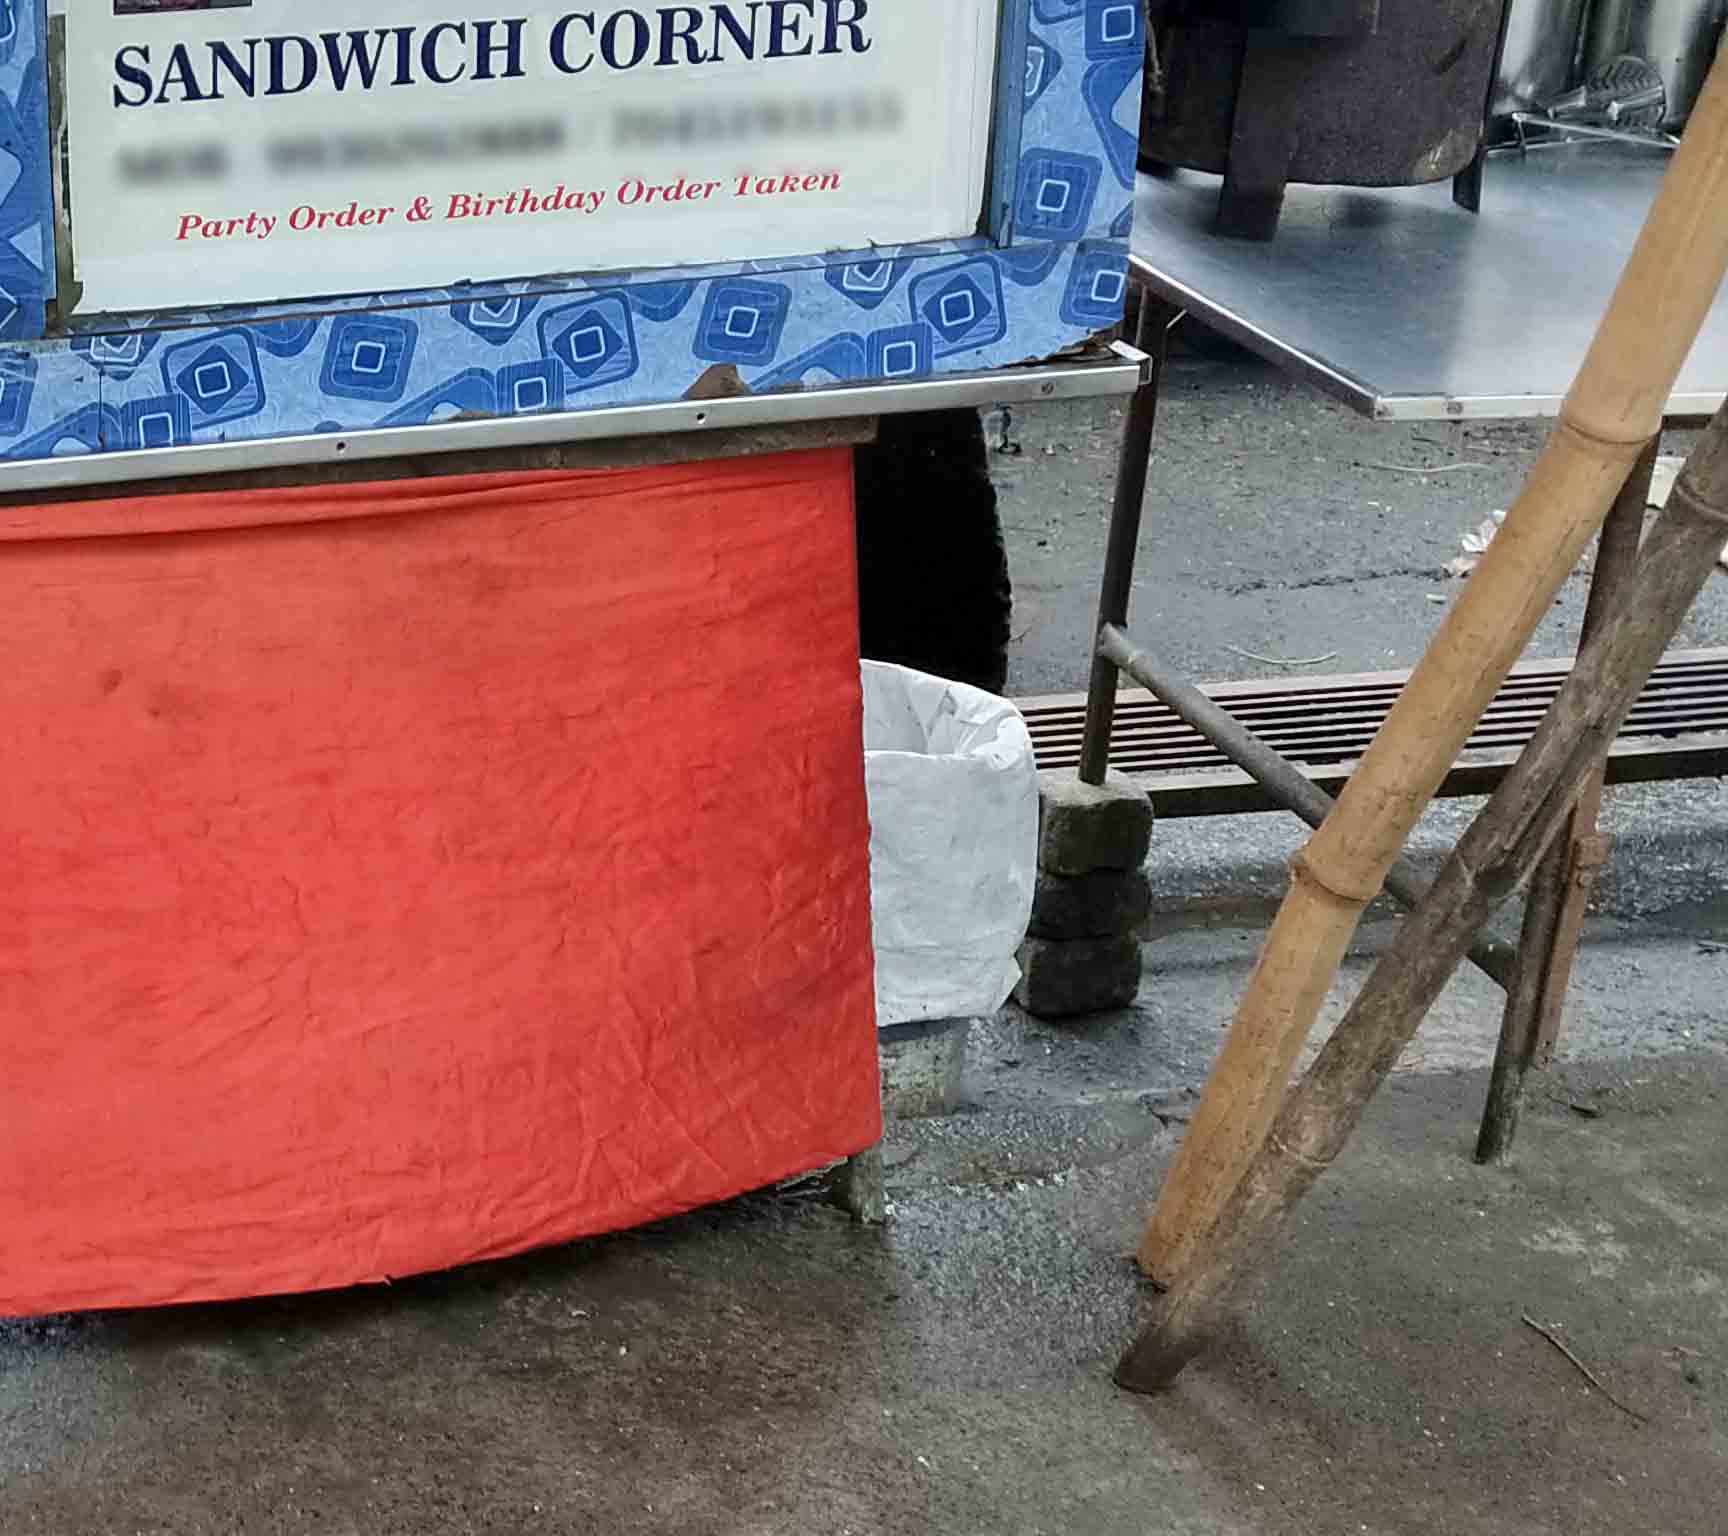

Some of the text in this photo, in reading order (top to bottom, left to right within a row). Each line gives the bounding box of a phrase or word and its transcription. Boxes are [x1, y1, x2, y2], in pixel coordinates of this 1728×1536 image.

[113, 17, 528, 108] SANDWICH
[176, 169, 841, 240] Party Order & Birthday Order Taken
